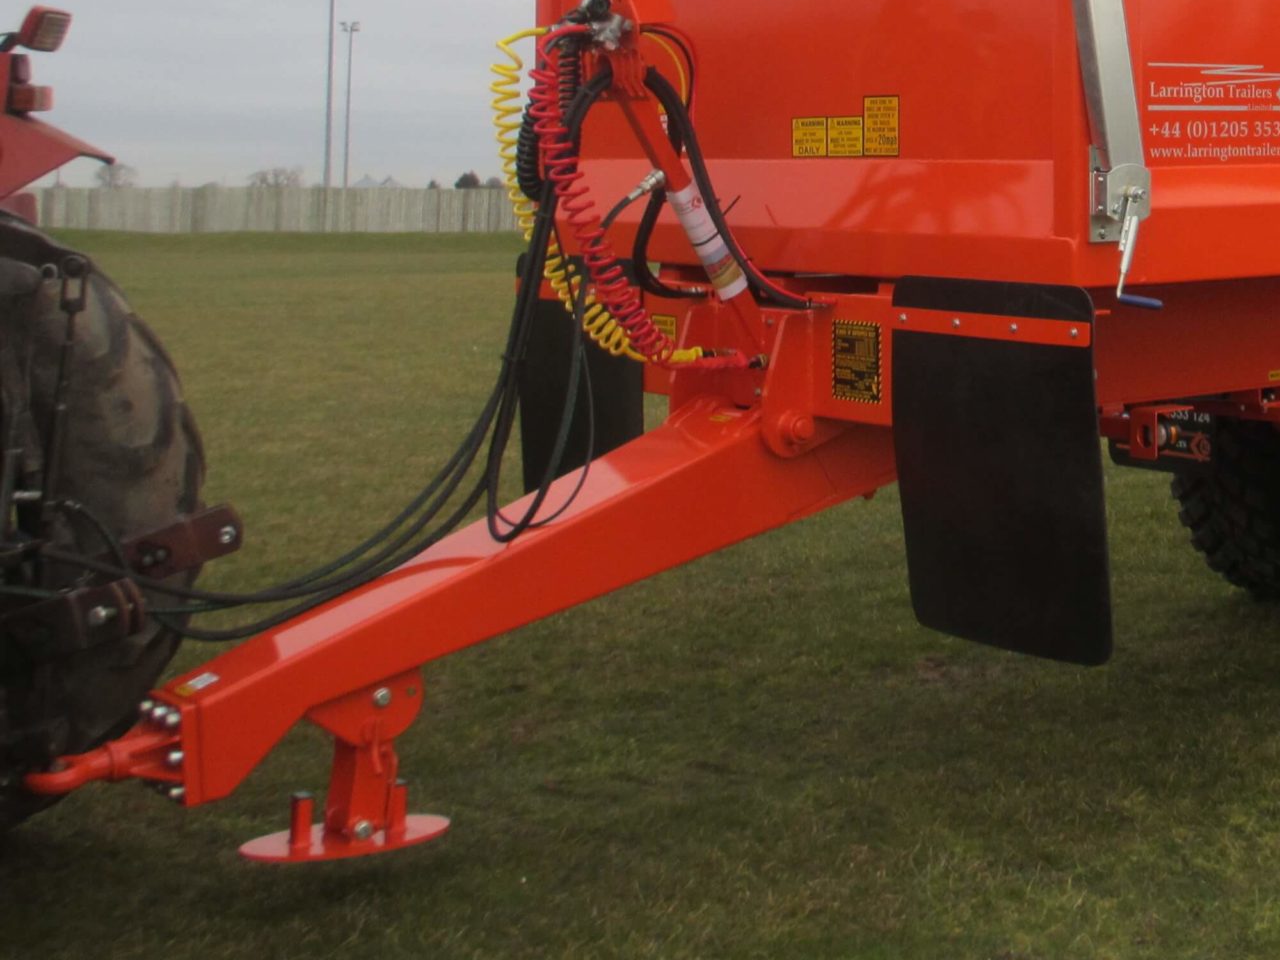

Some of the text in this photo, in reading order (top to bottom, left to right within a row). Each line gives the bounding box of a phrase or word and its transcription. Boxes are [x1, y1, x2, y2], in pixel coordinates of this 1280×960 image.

[1150, 81, 1272, 103] Larrington Trailers
[1149, 121, 1181, 138] +44
[1187, 120, 1248, 139] (0)1205
[1254, 121, 1280, 137] 353
[798, 146, 820, 155] DAILY
